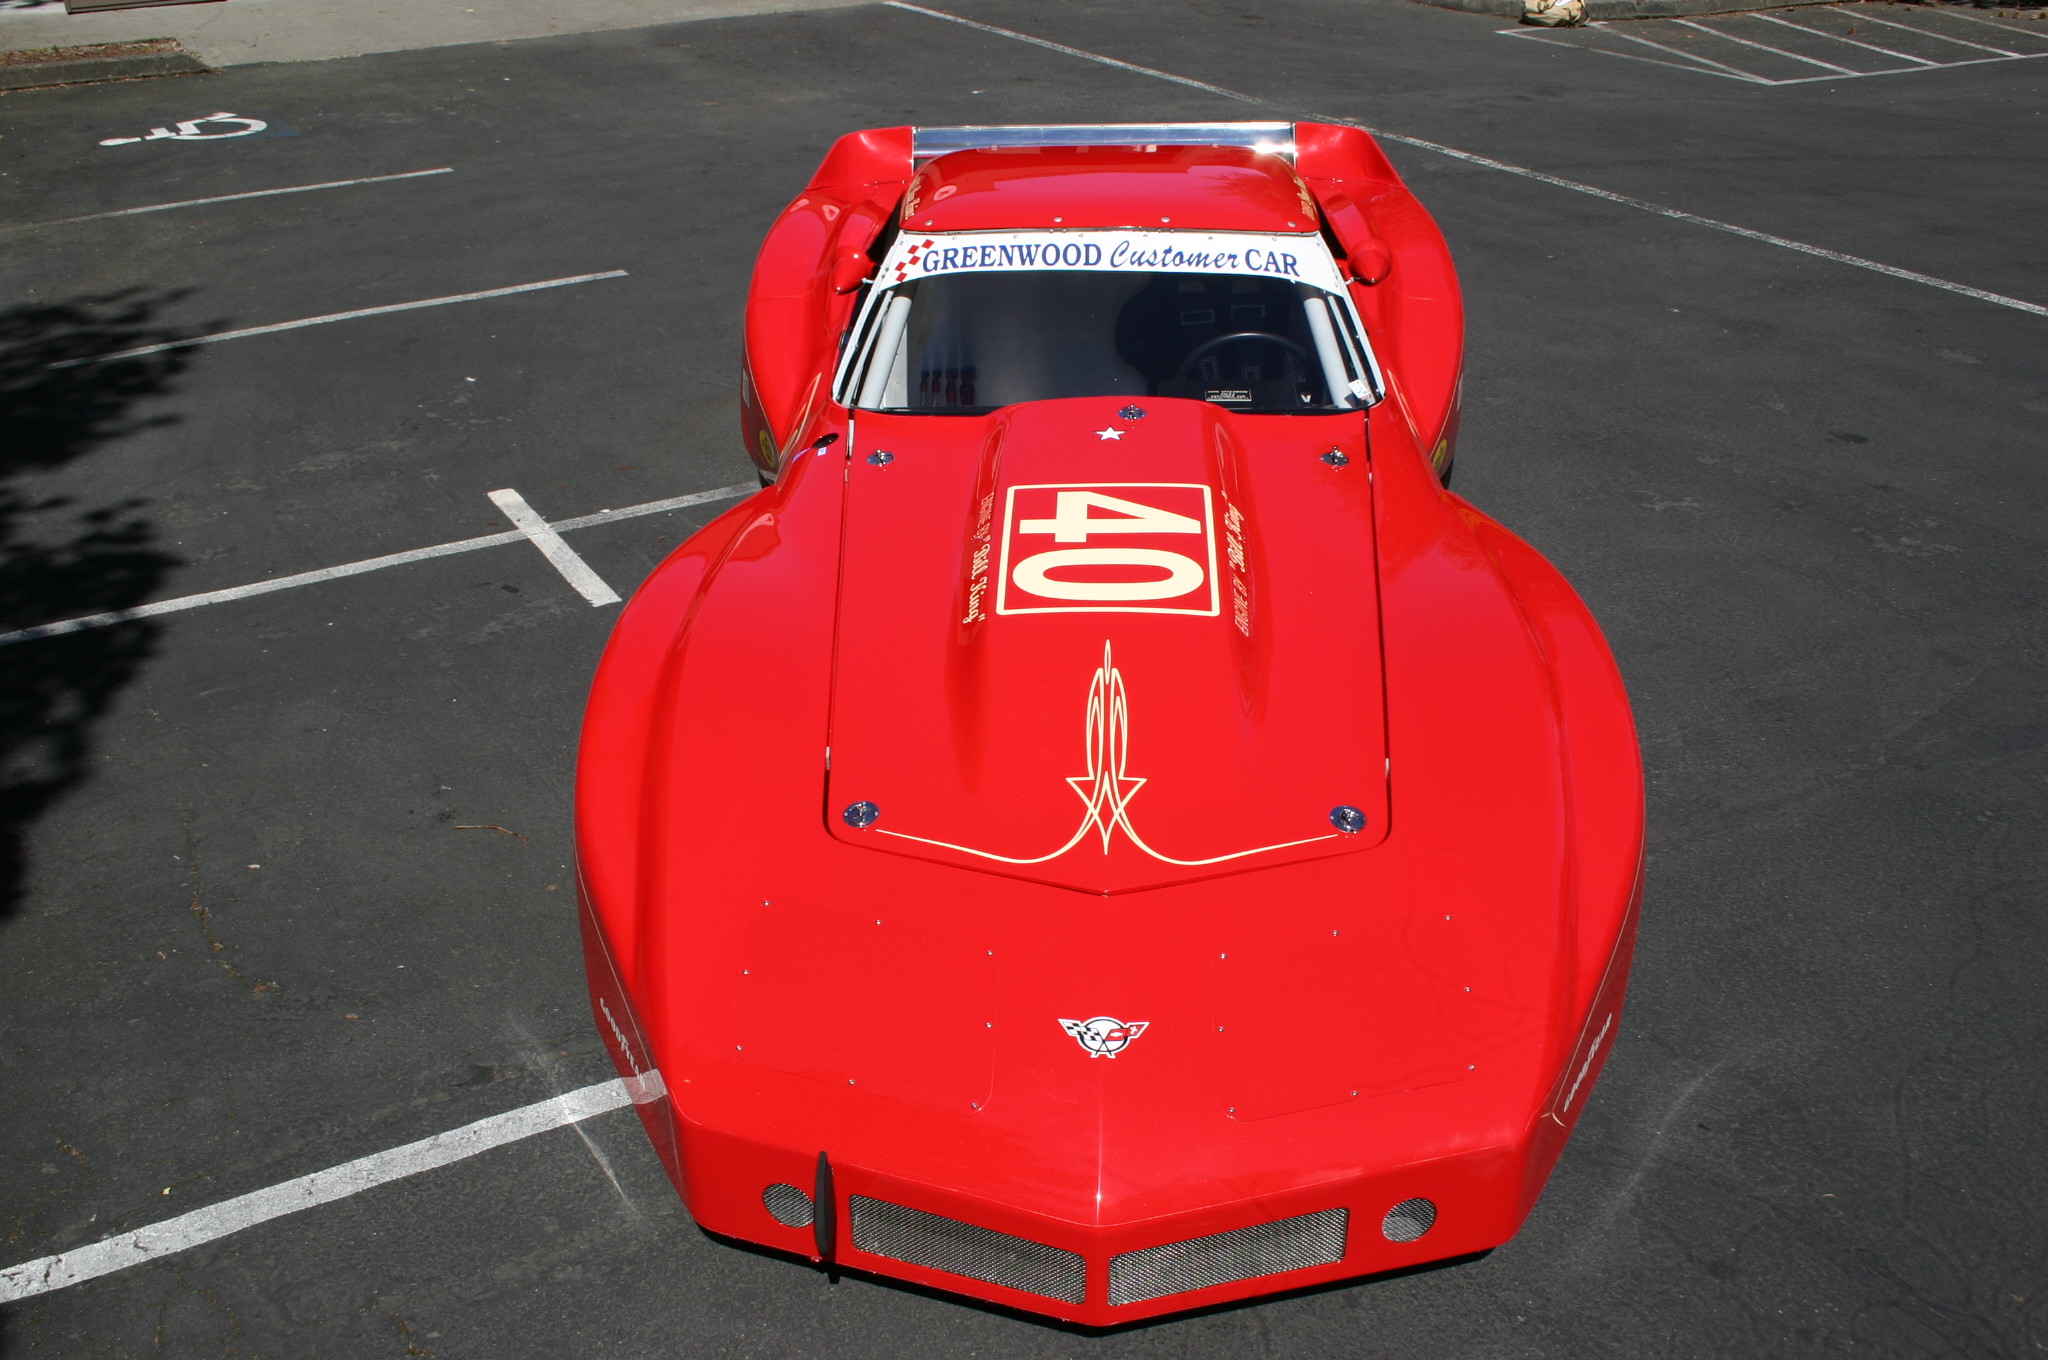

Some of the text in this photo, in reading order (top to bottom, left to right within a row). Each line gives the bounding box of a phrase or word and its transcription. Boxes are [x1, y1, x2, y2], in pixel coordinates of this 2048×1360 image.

[922, 240, 1301, 277] GREENWOOD Customer CAR
[1012, 490, 1205, 601] 40
